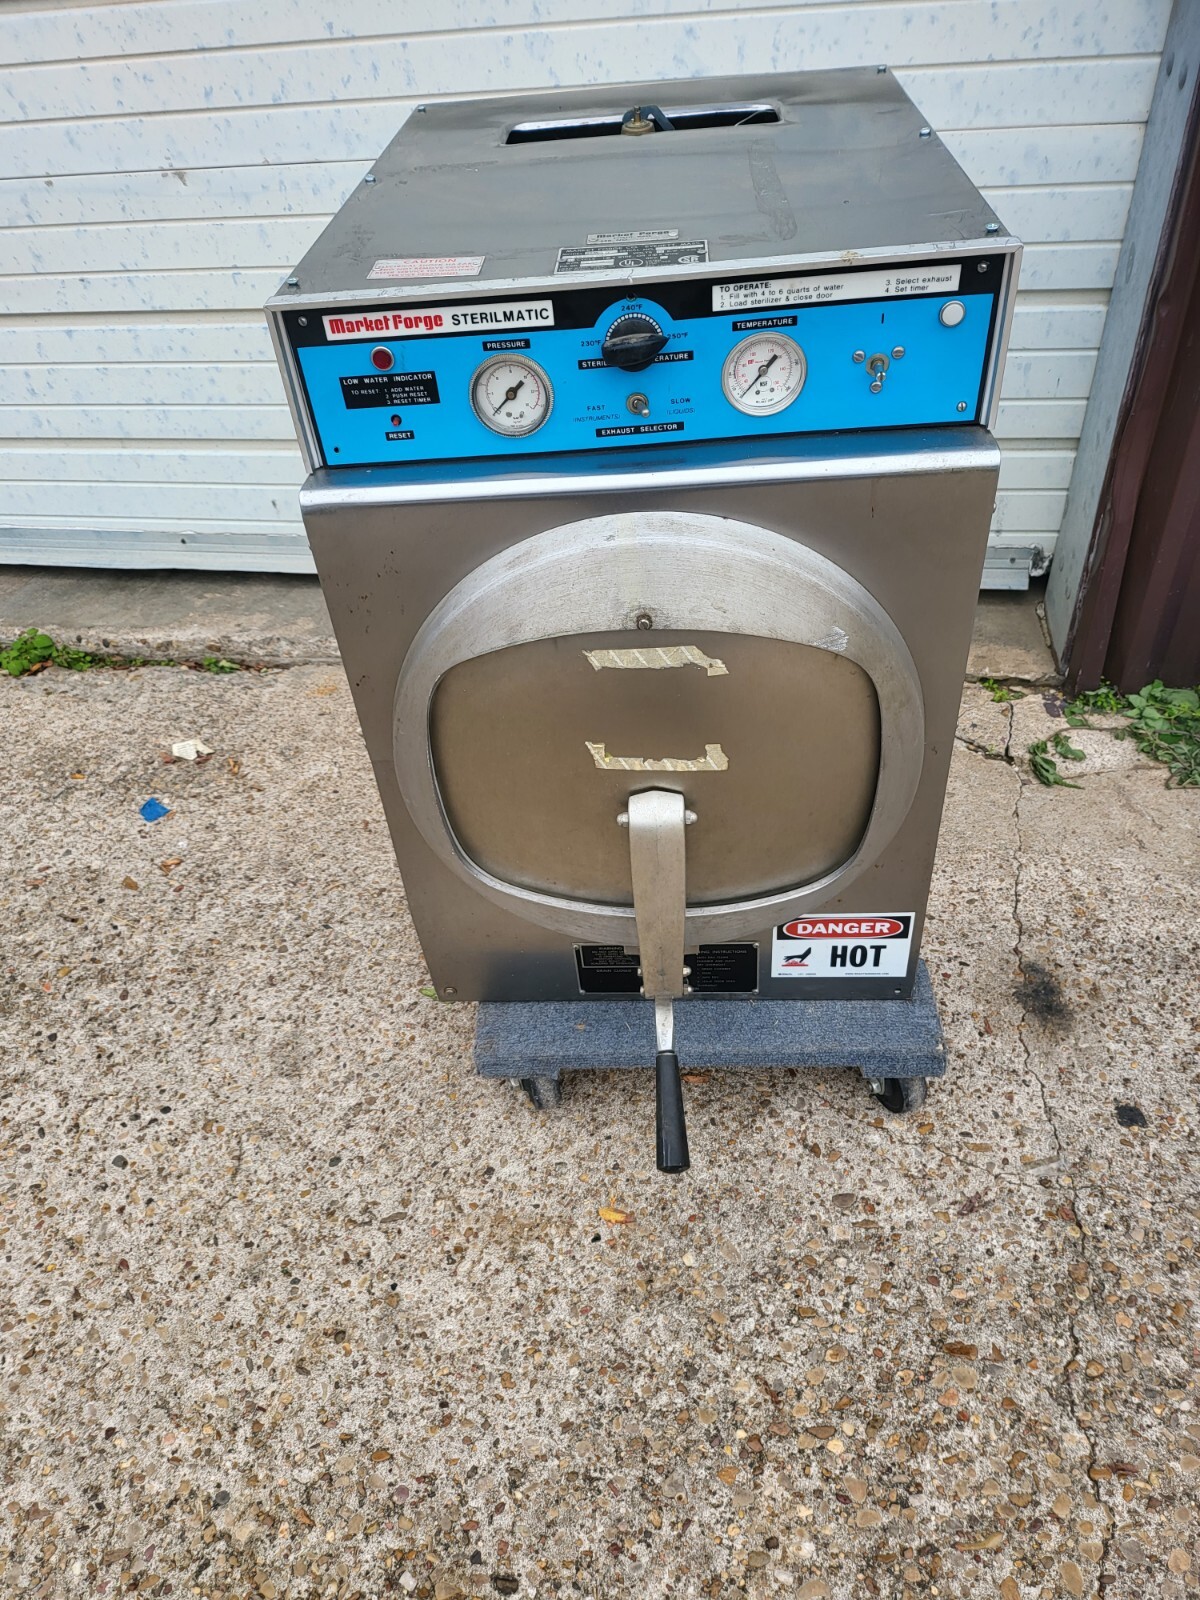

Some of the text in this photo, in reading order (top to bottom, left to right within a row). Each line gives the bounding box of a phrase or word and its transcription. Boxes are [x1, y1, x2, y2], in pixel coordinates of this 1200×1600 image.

[895, 277, 920, 285] Select
[922, 275, 953, 283] exhaust
[733, 282, 772, 292] OPERATE:
[786, 286, 810, 295] quarts
[910, 284, 930, 292] timer
[729, 299, 748, 308] Load
[750, 297, 782, 306] sterilizer
[793, 294, 813, 302] close
[816, 292, 833, 300] door
[328, 307, 550, 334] Market Forge STERILMATIC
[737, 317, 794, 329] TEMPERATURE
[667, 332, 689, 340] 250°F
[486, 340, 527, 350] PRESSURE
[654, 352, 689, 362] ERATURE
[342, 373, 433, 386] LOW WATER INDICATOR
[670, 397, 691, 405] SLOW
[601, 424, 678, 436] EXHAUST SELECTOR
[388, 432, 412, 440] RESET
[797, 922, 891, 935] DANGER
[830, 944, 887, 968] HOT
